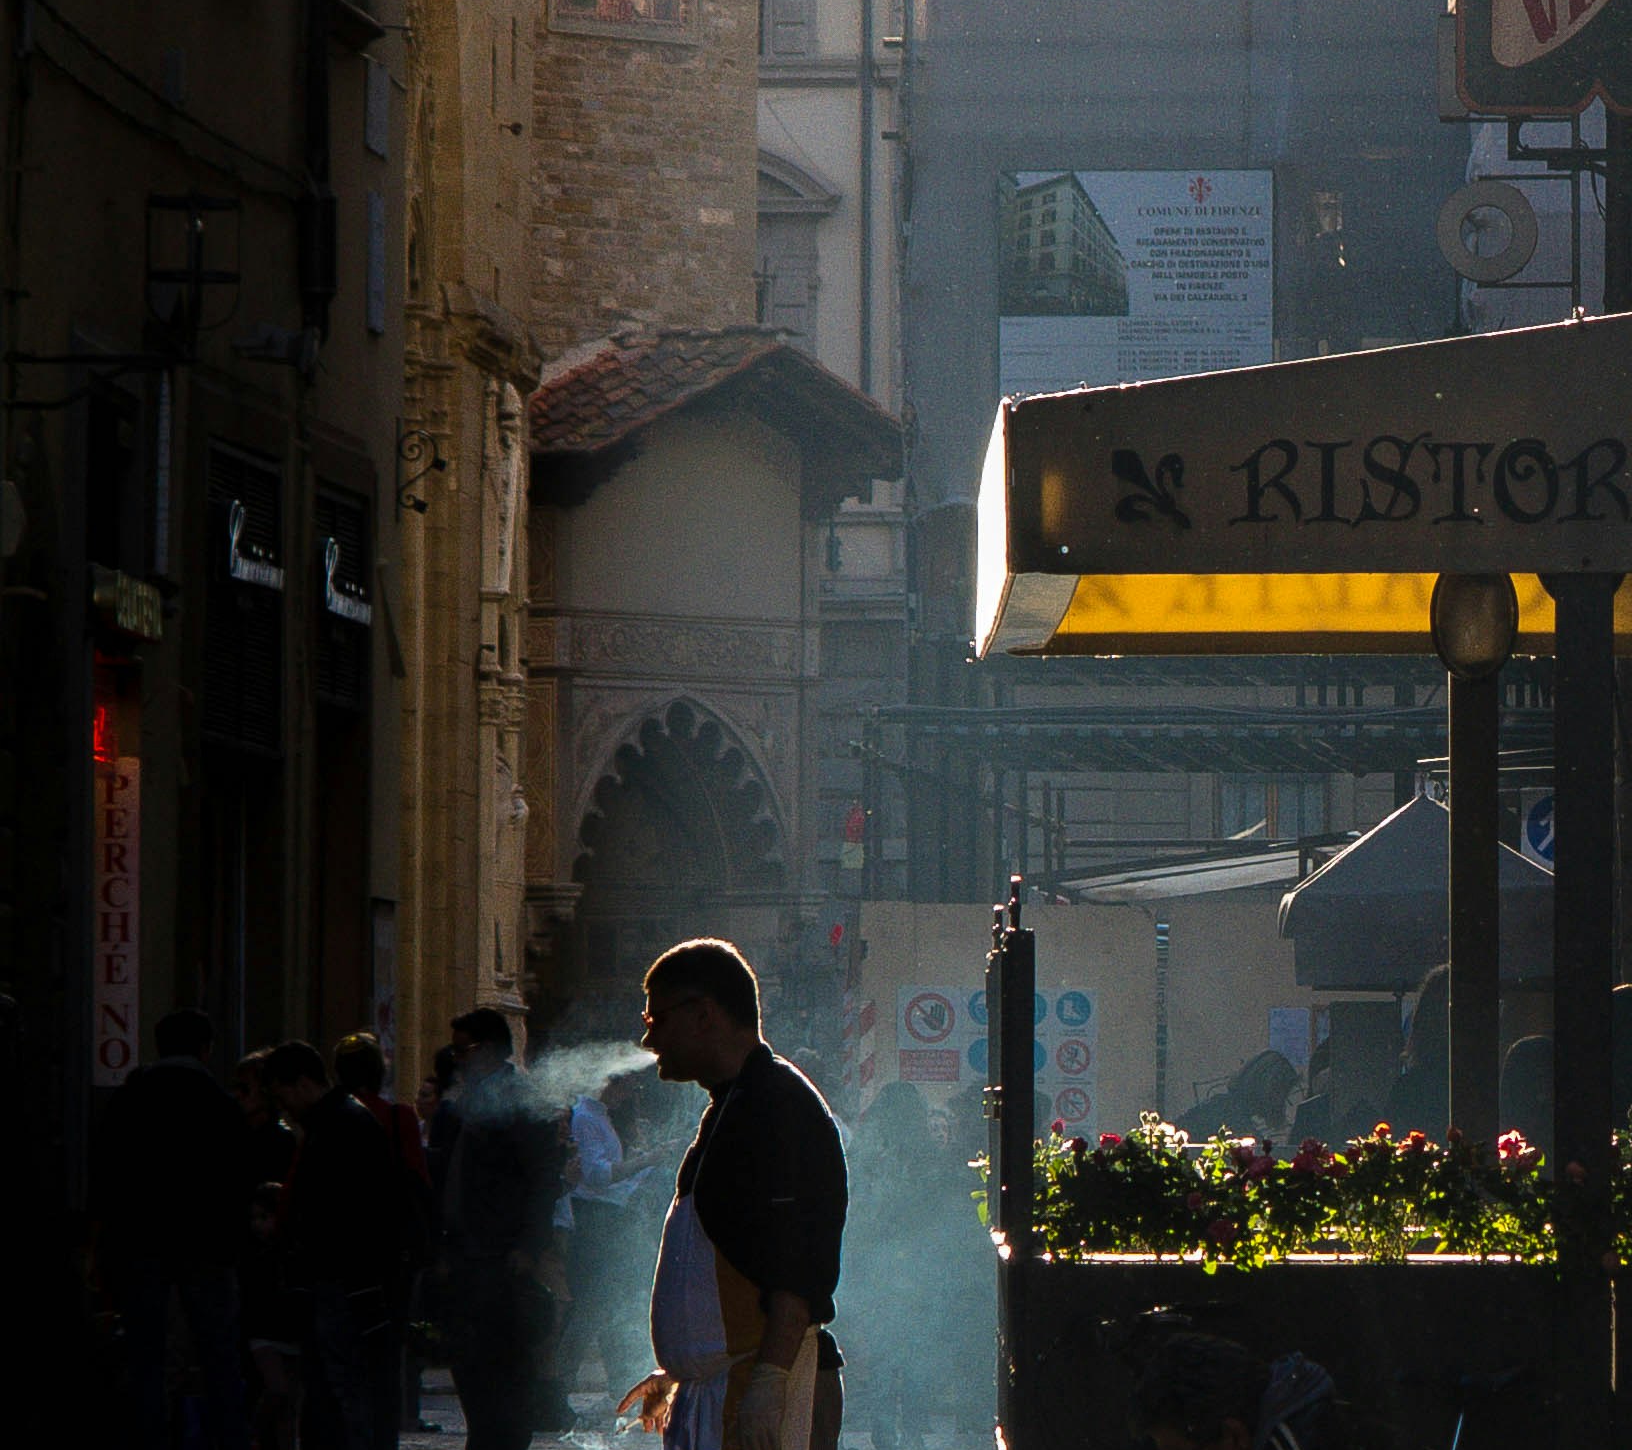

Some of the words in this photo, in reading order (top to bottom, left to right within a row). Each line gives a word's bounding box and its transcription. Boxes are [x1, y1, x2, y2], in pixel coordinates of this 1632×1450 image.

[1137, 206, 1191, 216] COMUNE
[1194, 206, 1207, 216] DI
[1211, 206, 1262, 216] FIRENZE
[1184, 227, 1193, 235] DI
[1201, 238, 1265, 246] CONSERVATIVO
[1150, 249, 1168, 257] CON
[1170, 249, 1243, 257] FRAZIONAMENTO
[1167, 260, 1176, 268] DI
[1178, 260, 1240, 268] DESTINAZIONE
[1220, 271, 1249, 279] POSTO
[1176, 282, 1186, 290] IN
[1188, 282, 1224, 290] FIRENZE
[1154, 293, 1168, 301] VIA
[1170, 293, 1185, 301] DEI
